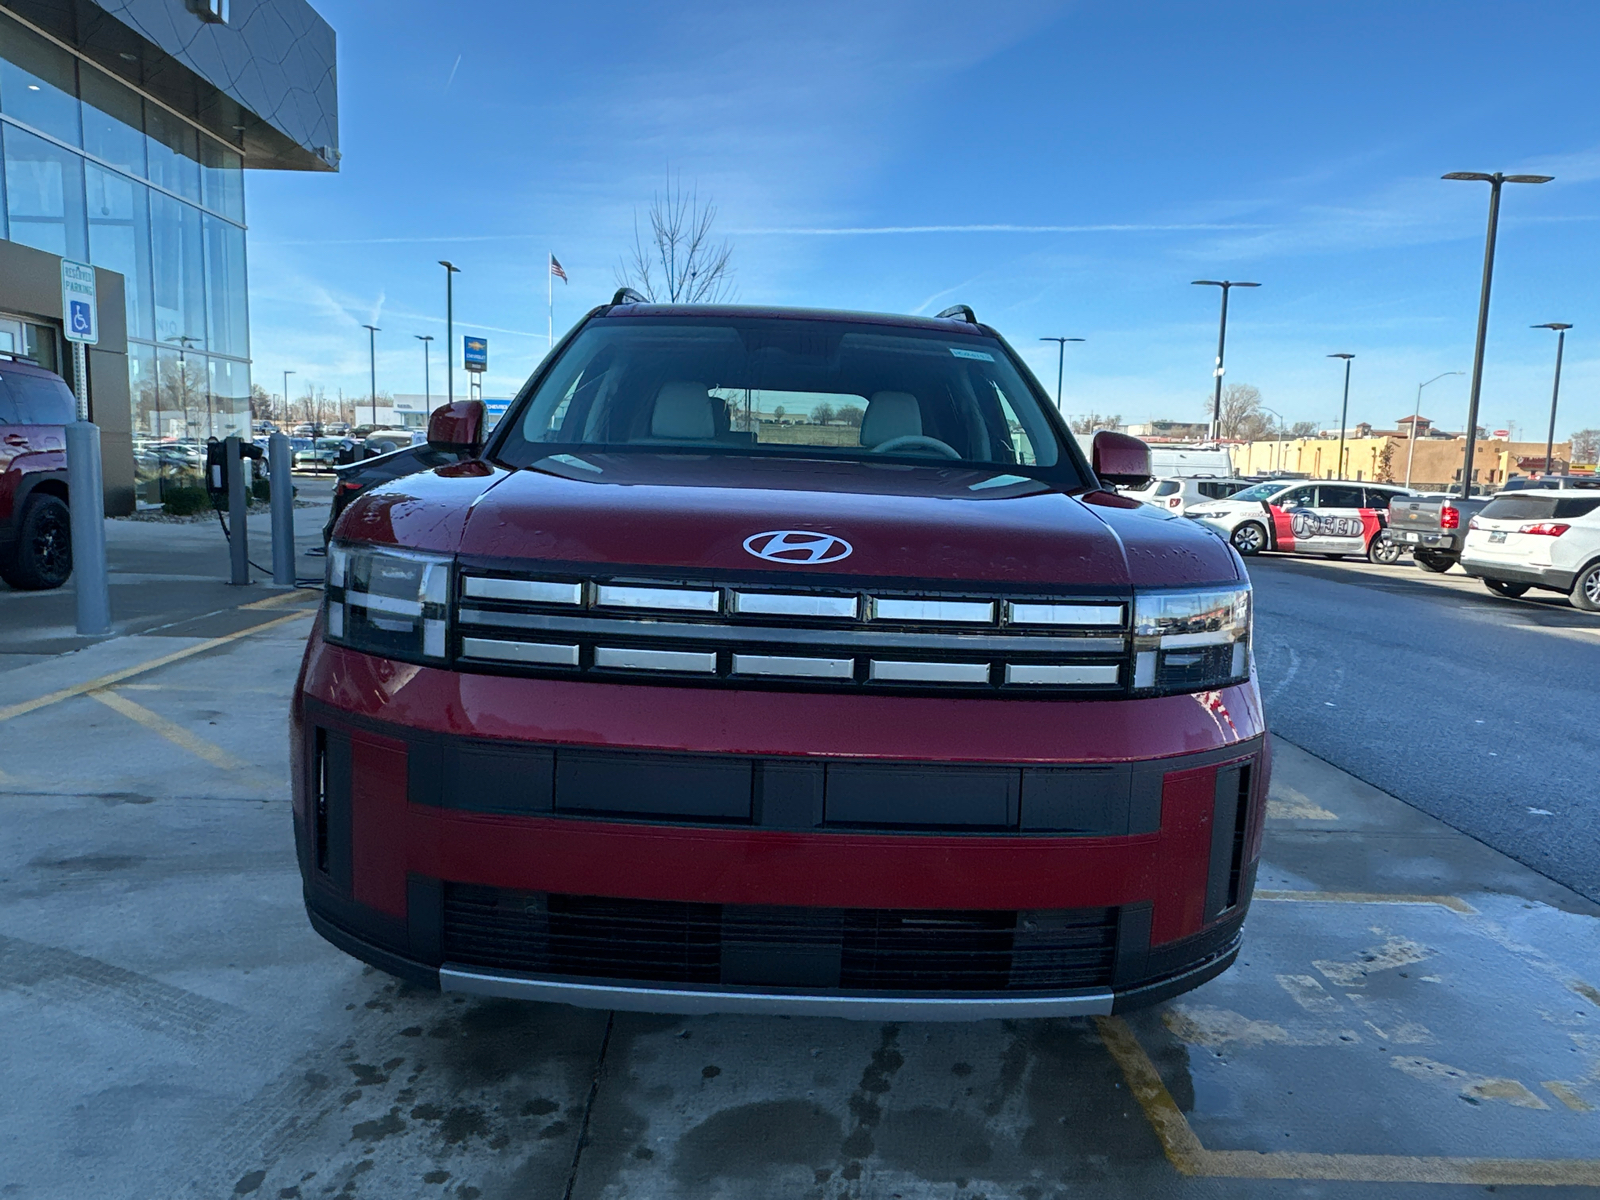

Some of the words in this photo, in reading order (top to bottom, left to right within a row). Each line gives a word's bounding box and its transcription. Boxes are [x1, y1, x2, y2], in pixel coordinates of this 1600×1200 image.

[65, 266, 92, 282] RESERVED
[65, 280, 93, 296] PARKING
[1293, 512, 1362, 537] REED
